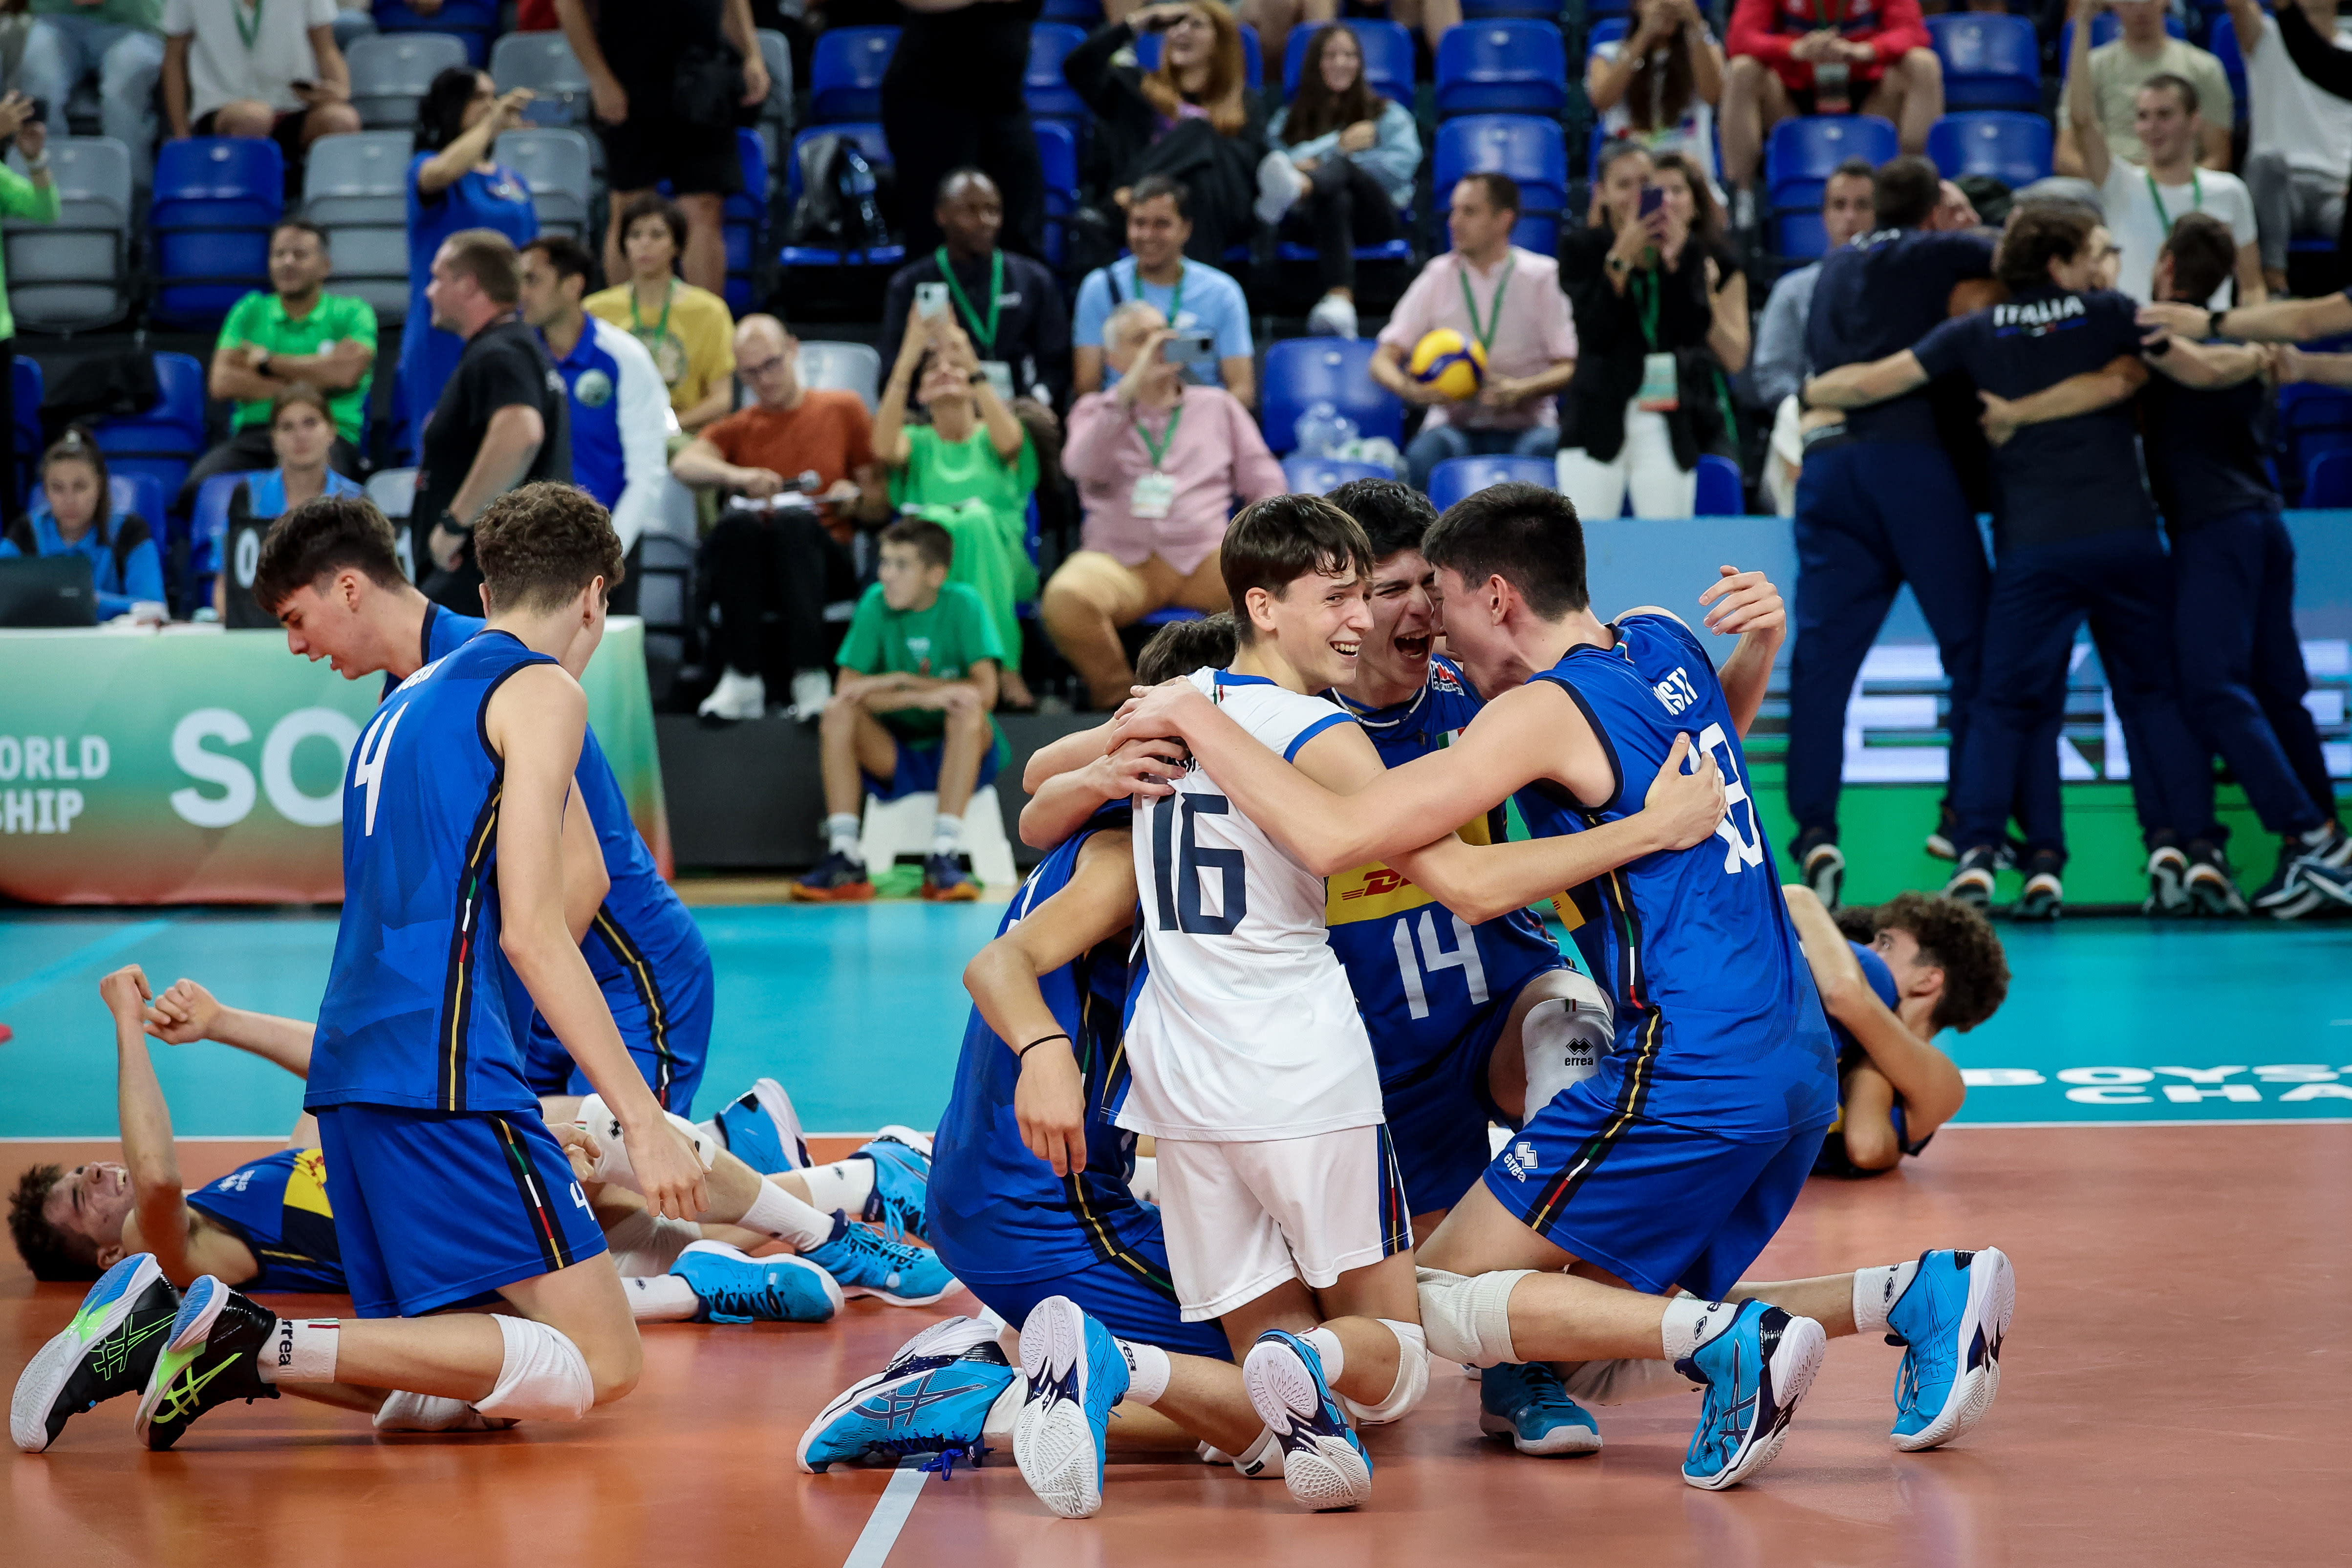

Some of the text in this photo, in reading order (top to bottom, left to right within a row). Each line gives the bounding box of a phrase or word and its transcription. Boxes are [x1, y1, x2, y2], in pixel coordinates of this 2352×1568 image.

[1993, 295, 2086, 327] ITALIA
[234, 527, 260, 589] 0
[355, 702, 410, 837] 4
[0, 788, 85, 835] HIP
[1152, 791, 1247, 935] 16
[1393, 909, 1489, 1020] 14
[1565, 1057, 1594, 1066] errea
[1503, 1152, 1526, 1183] errea
[570, 1180, 595, 1221] 4
